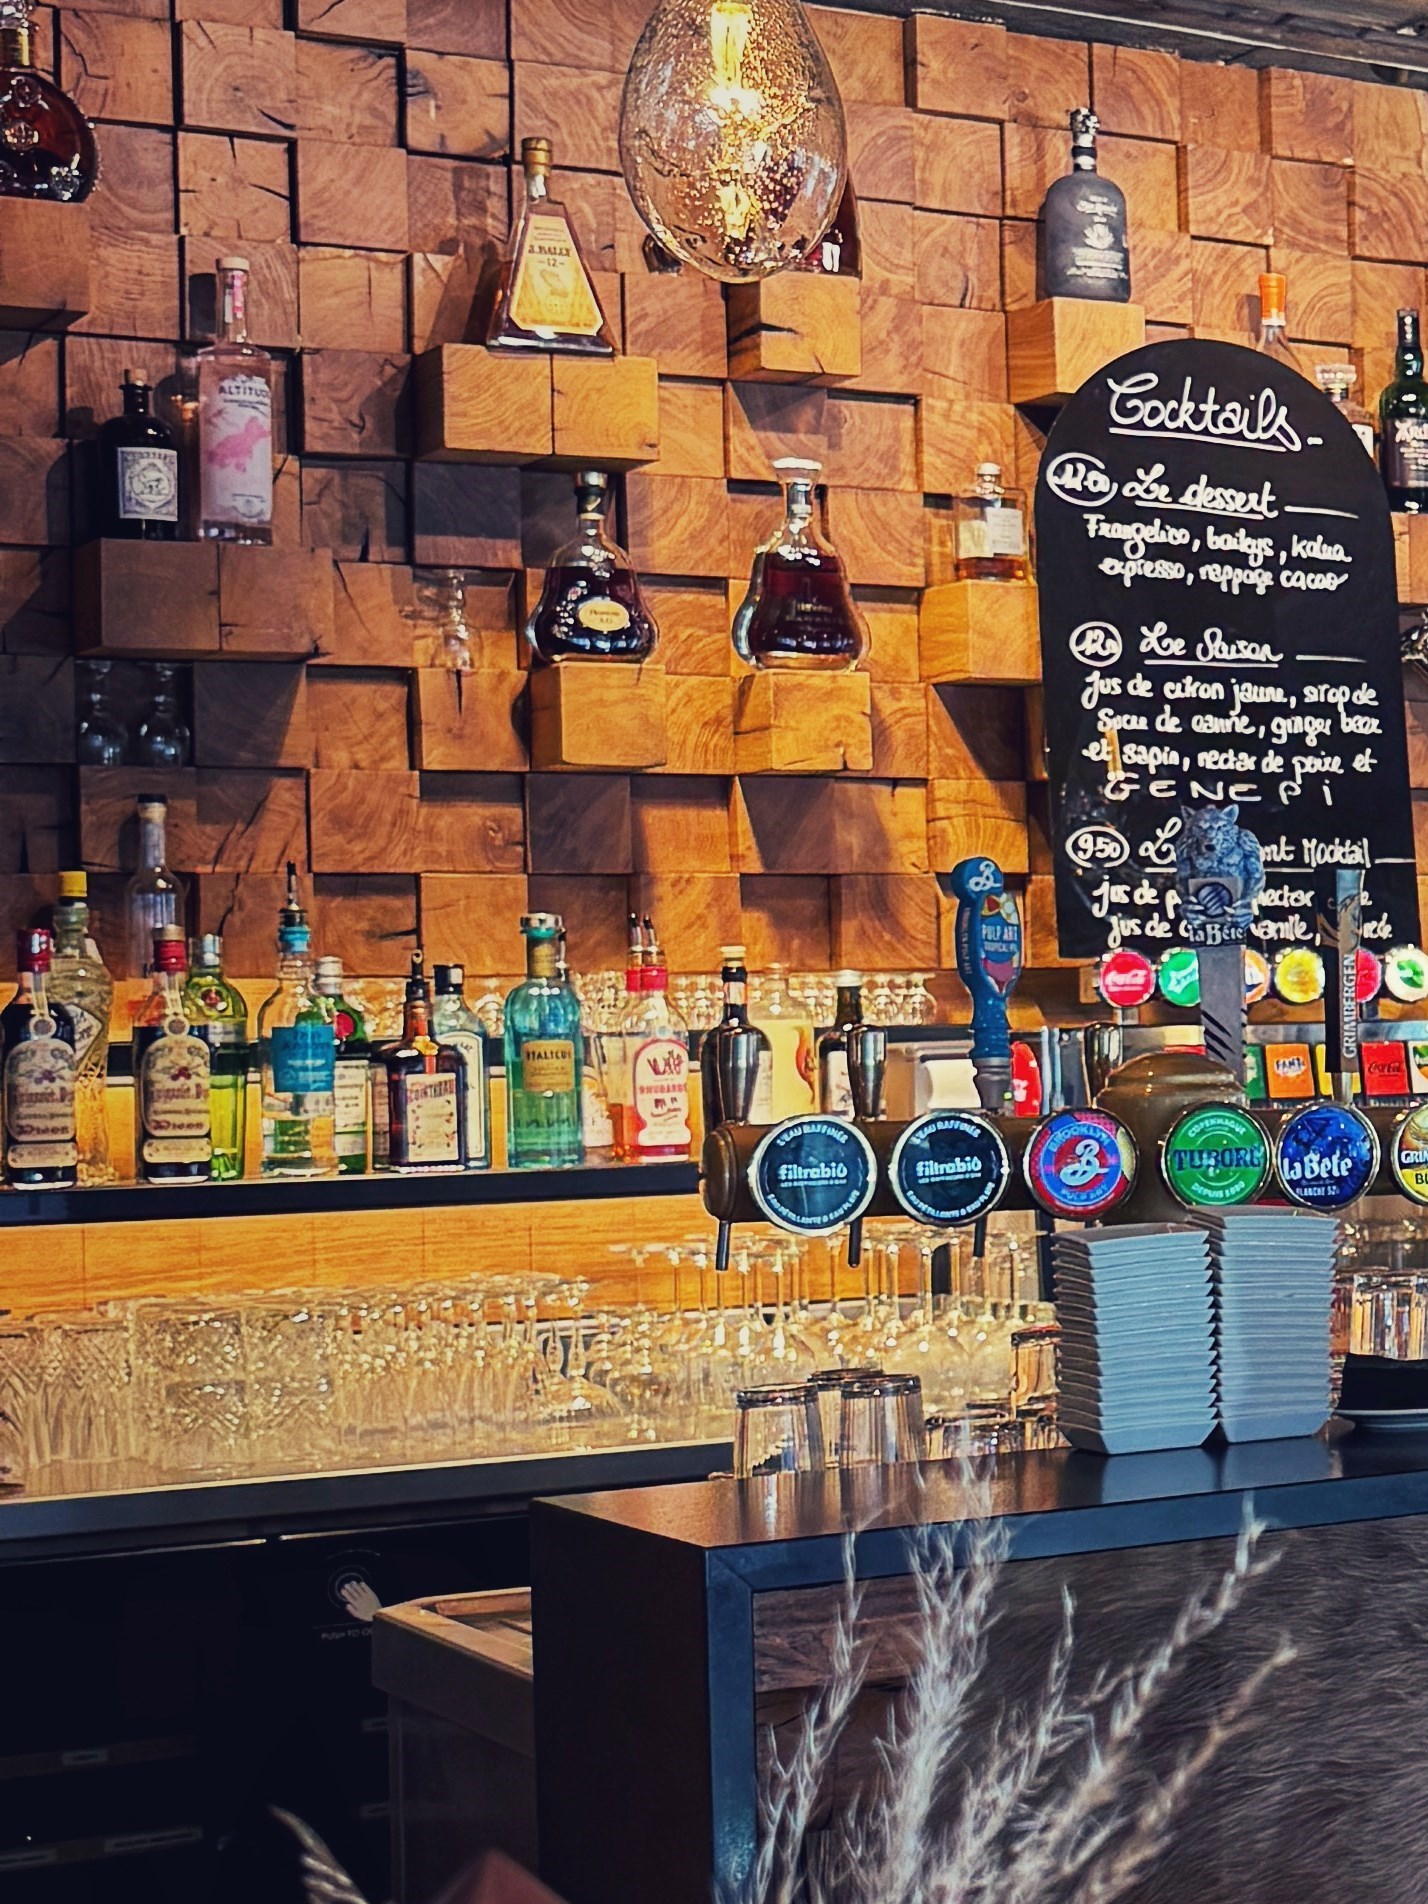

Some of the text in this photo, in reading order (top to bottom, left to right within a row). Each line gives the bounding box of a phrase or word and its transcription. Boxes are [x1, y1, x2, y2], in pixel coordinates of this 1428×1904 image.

[1107, 372, 1302, 452] Cocktails
[1122, 463, 1173, 503] Le
[1179, 474, 1280, 519] dessert
[1279, 569, 1349, 592] cacao
[1139, 621, 1187, 658] Le
[1196, 627, 1284, 662] Saison
[1126, 672, 1154, 698] de
[1163, 674, 1226, 701] citron
[1303, 683, 1350, 712] sirop
[1351, 682, 1380, 706] de
[1155, 704, 1184, 734] de
[1270, 713, 1333, 748] ginger
[1340, 710, 1384, 736] beer
[1081, 739, 1113, 763] et
[1197, 748, 1257, 774] nectar
[1261, 748, 1285, 773] de
[1291, 757, 1346, 785] poire
[1352, 747, 1378, 774] et
[1134, 878, 1160, 905] de
[981, 924, 1019, 942] PULP ART
[1145, 914, 1174, 940] de
[1343, 953, 1357, 1058] GRIMBERGEN
[1047, 1125, 1112, 1152] BROOKLYN
[1173, 1143, 1262, 1173] TUBORG
